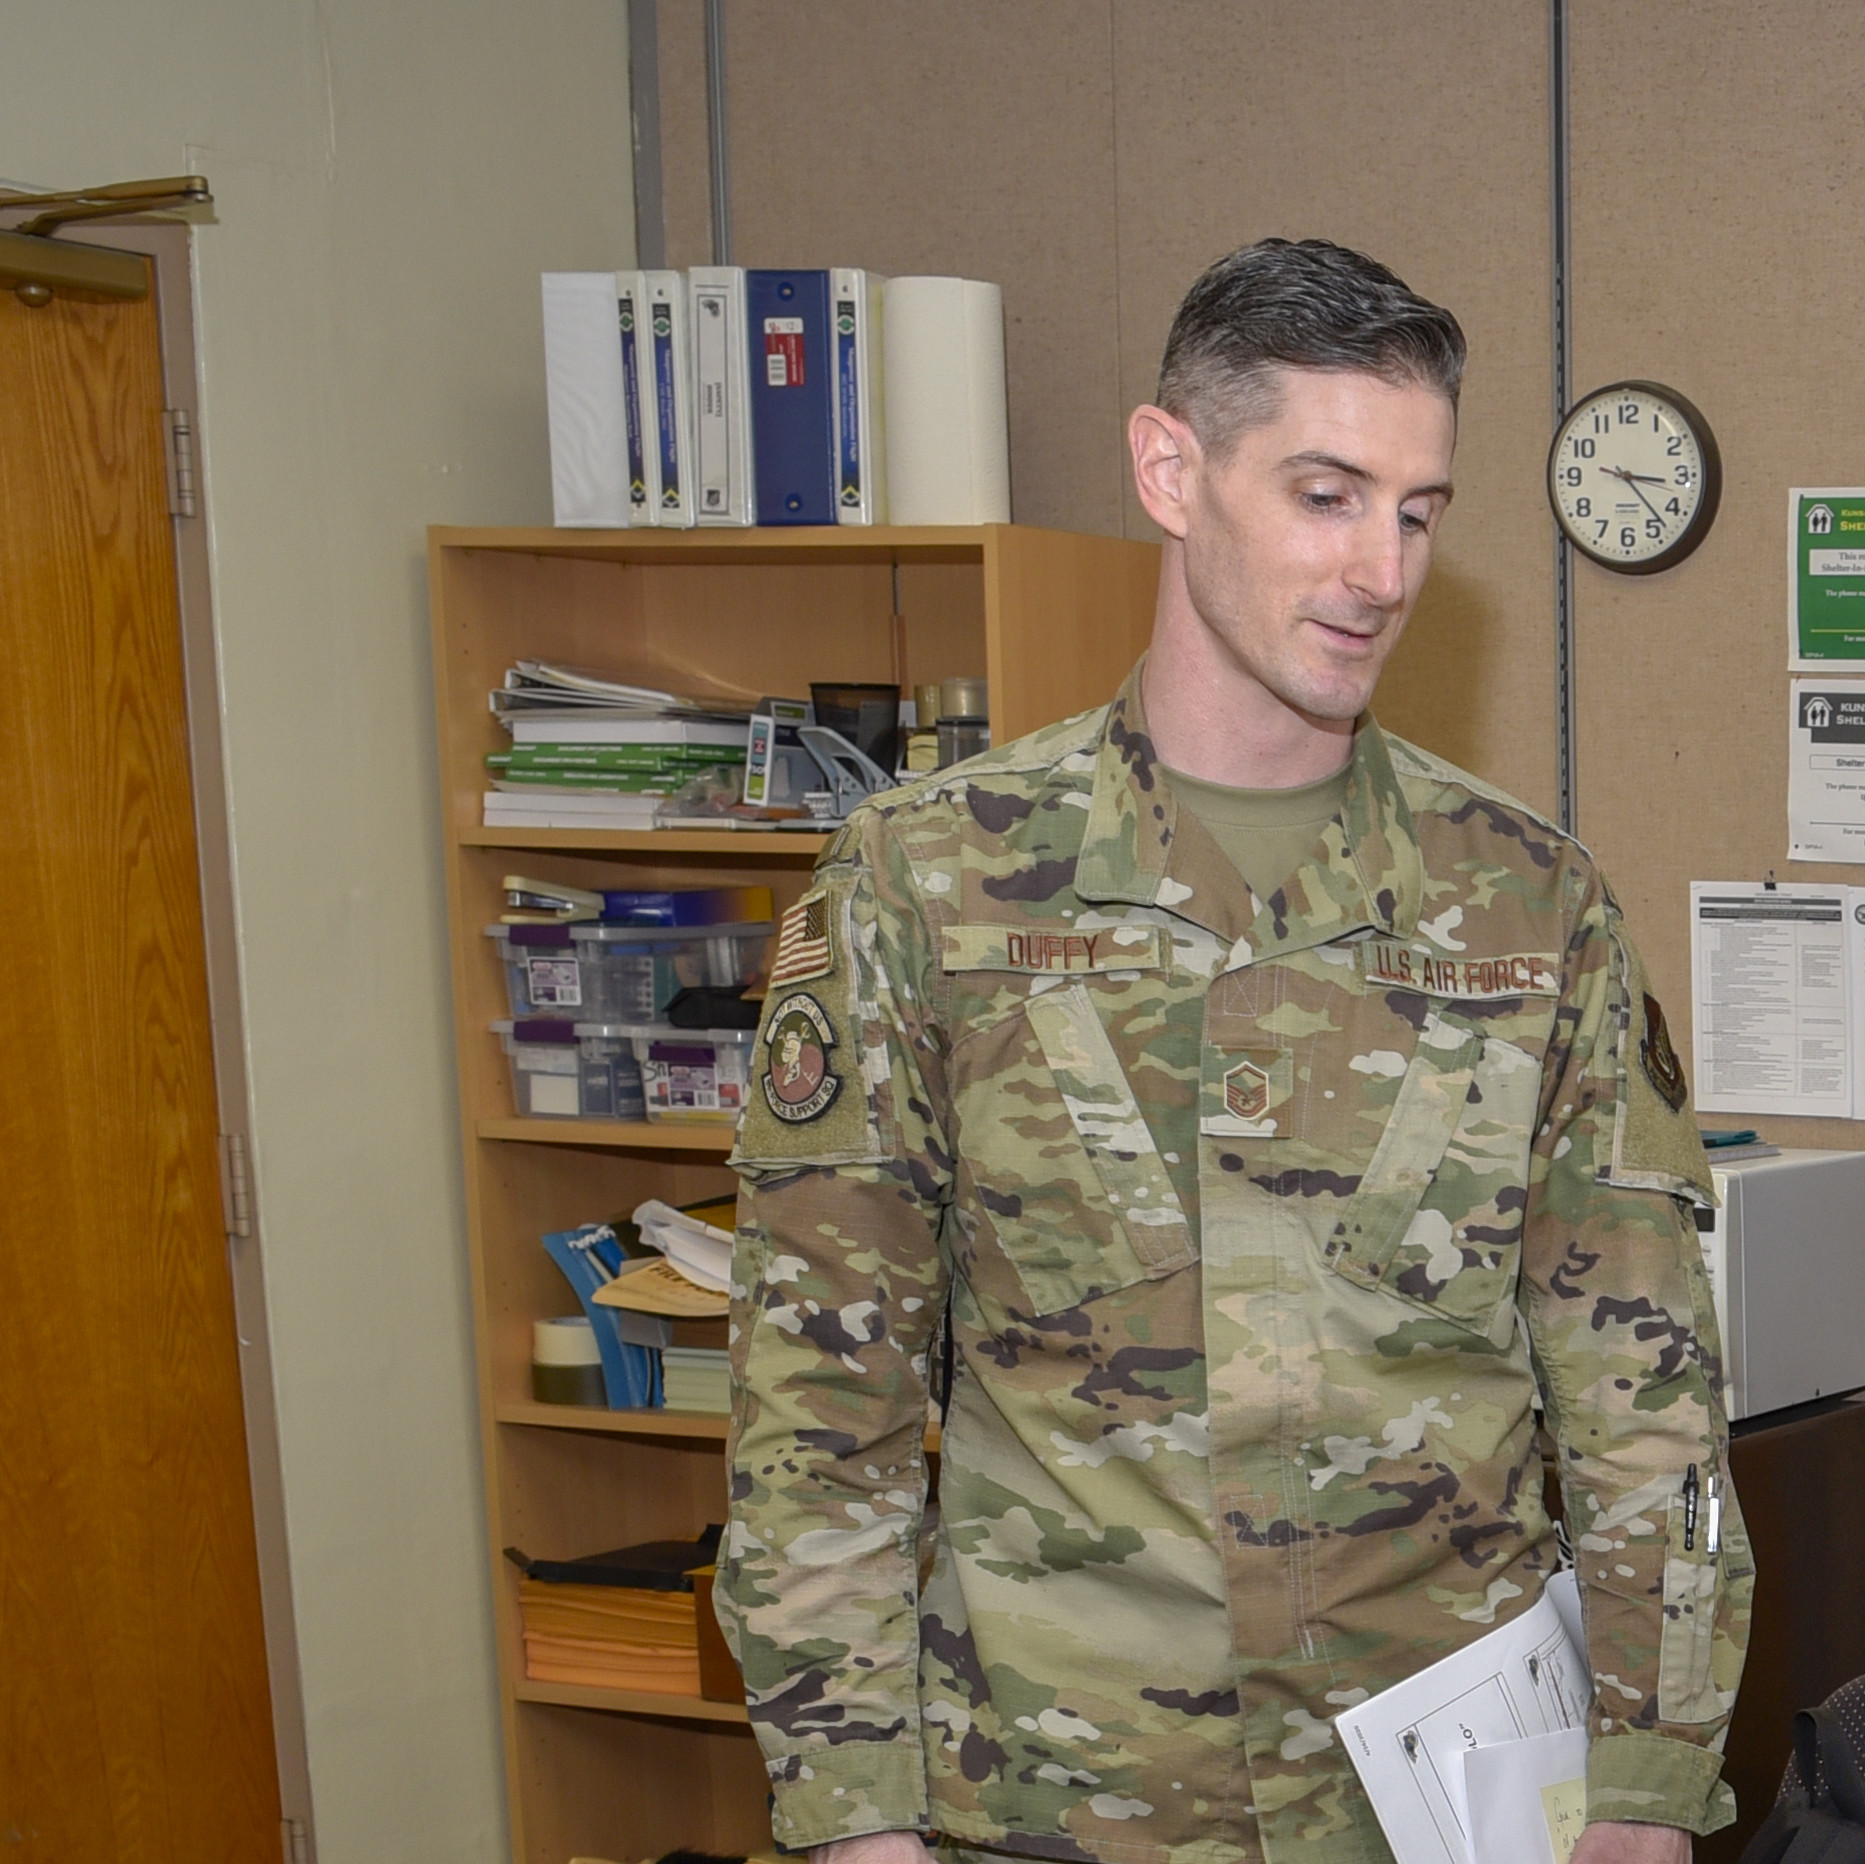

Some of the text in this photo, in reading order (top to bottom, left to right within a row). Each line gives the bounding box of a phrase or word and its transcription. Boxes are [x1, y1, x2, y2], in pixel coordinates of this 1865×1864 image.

[1594, 414, 1610, 434] 11
[1618, 404, 1640, 424] 12
[1574, 438, 1596, 459] 10
[1667, 436, 1682, 456] 2
[1566, 466, 1582, 487] 9
[1674, 465, 1690, 486] 3
[1576, 497, 1592, 518] 8
[1665, 497, 1680, 516] 4
[1595, 519, 1609, 539] 7
[1620, 527, 1636, 547] 6
[1645, 519, 1661, 540] 5
[1839, 552, 1857, 560] This
[1007, 932, 1099, 969] DUFFY
[1423, 956, 1458, 993] AIR
[1463, 955, 1543, 993] FORCE
